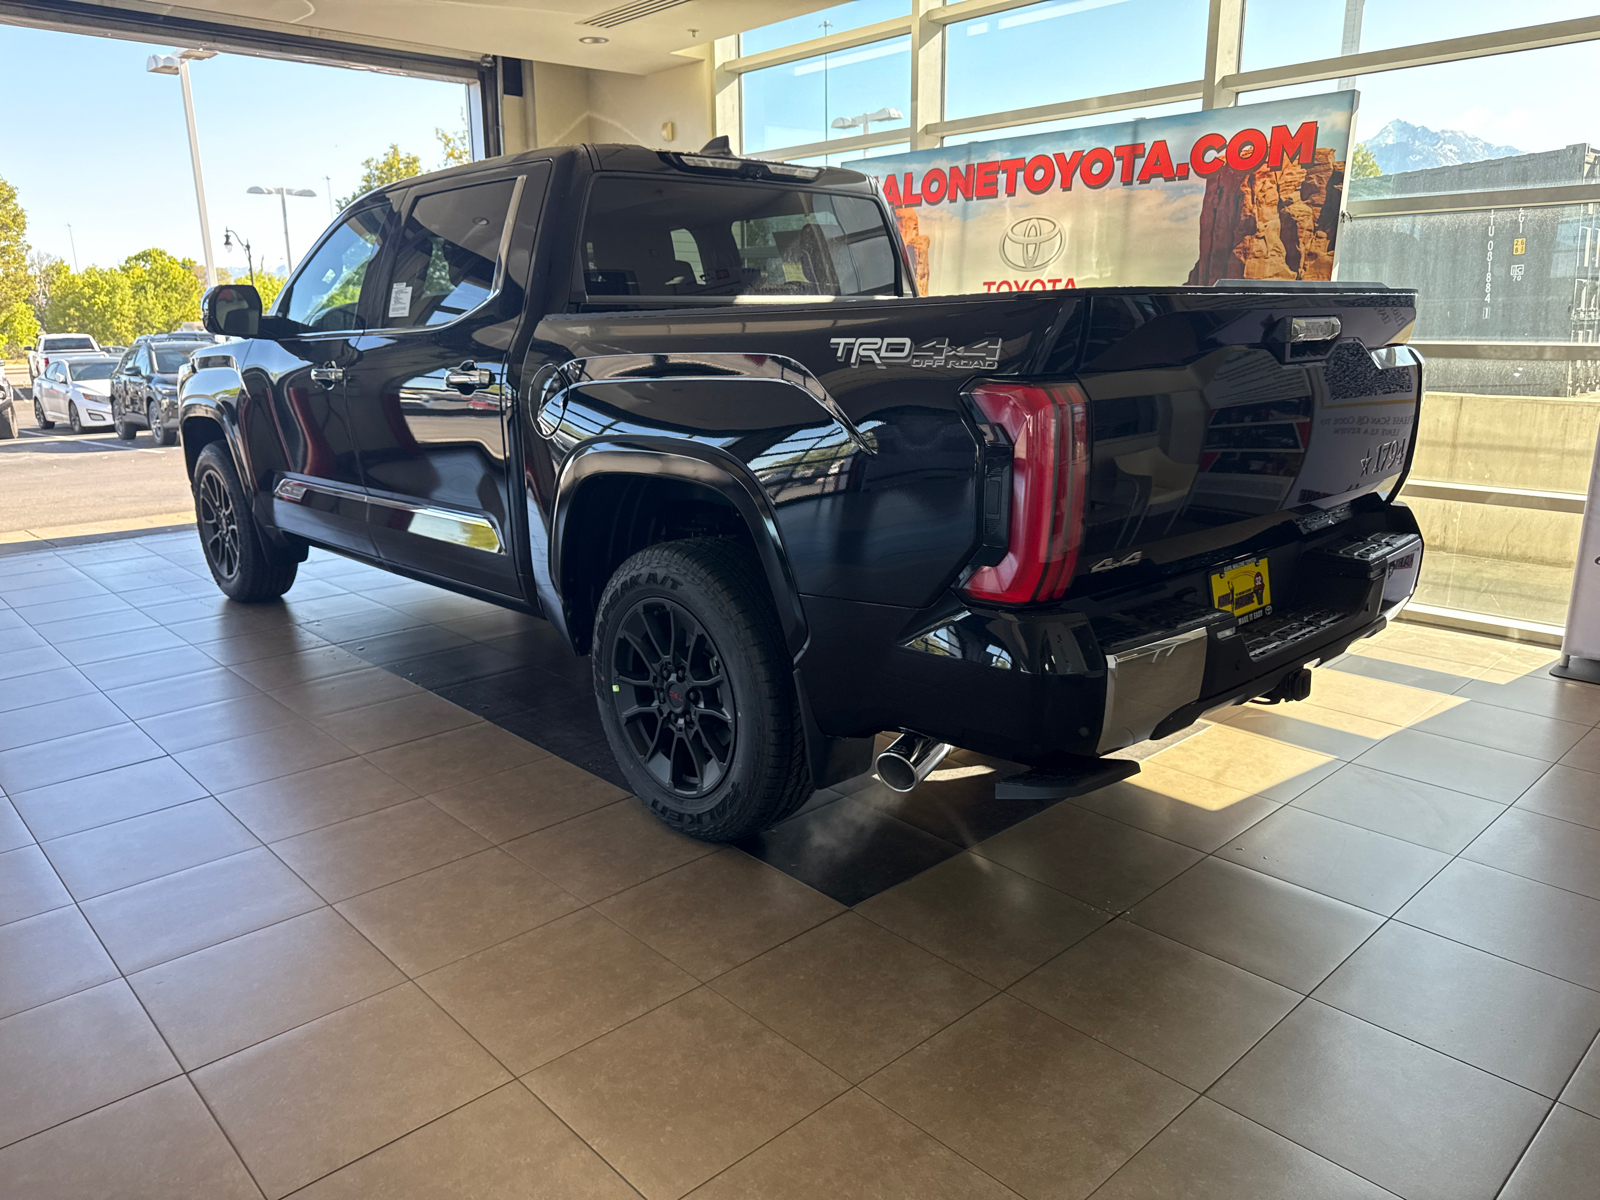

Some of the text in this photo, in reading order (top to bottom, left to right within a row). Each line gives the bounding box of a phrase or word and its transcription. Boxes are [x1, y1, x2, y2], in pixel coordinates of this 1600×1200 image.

[875, 120, 1318, 208] ALONETOYOTA.COM
[830, 337, 915, 369] TRD
[911, 358, 999, 370] OFF ROAD
[1372, 437, 1406, 475] 1794
[1089, 551, 1142, 573] 4x4
[1255, 576, 1262, 586] 32
[1238, 609, 1263, 625] MAKE IT EASY
